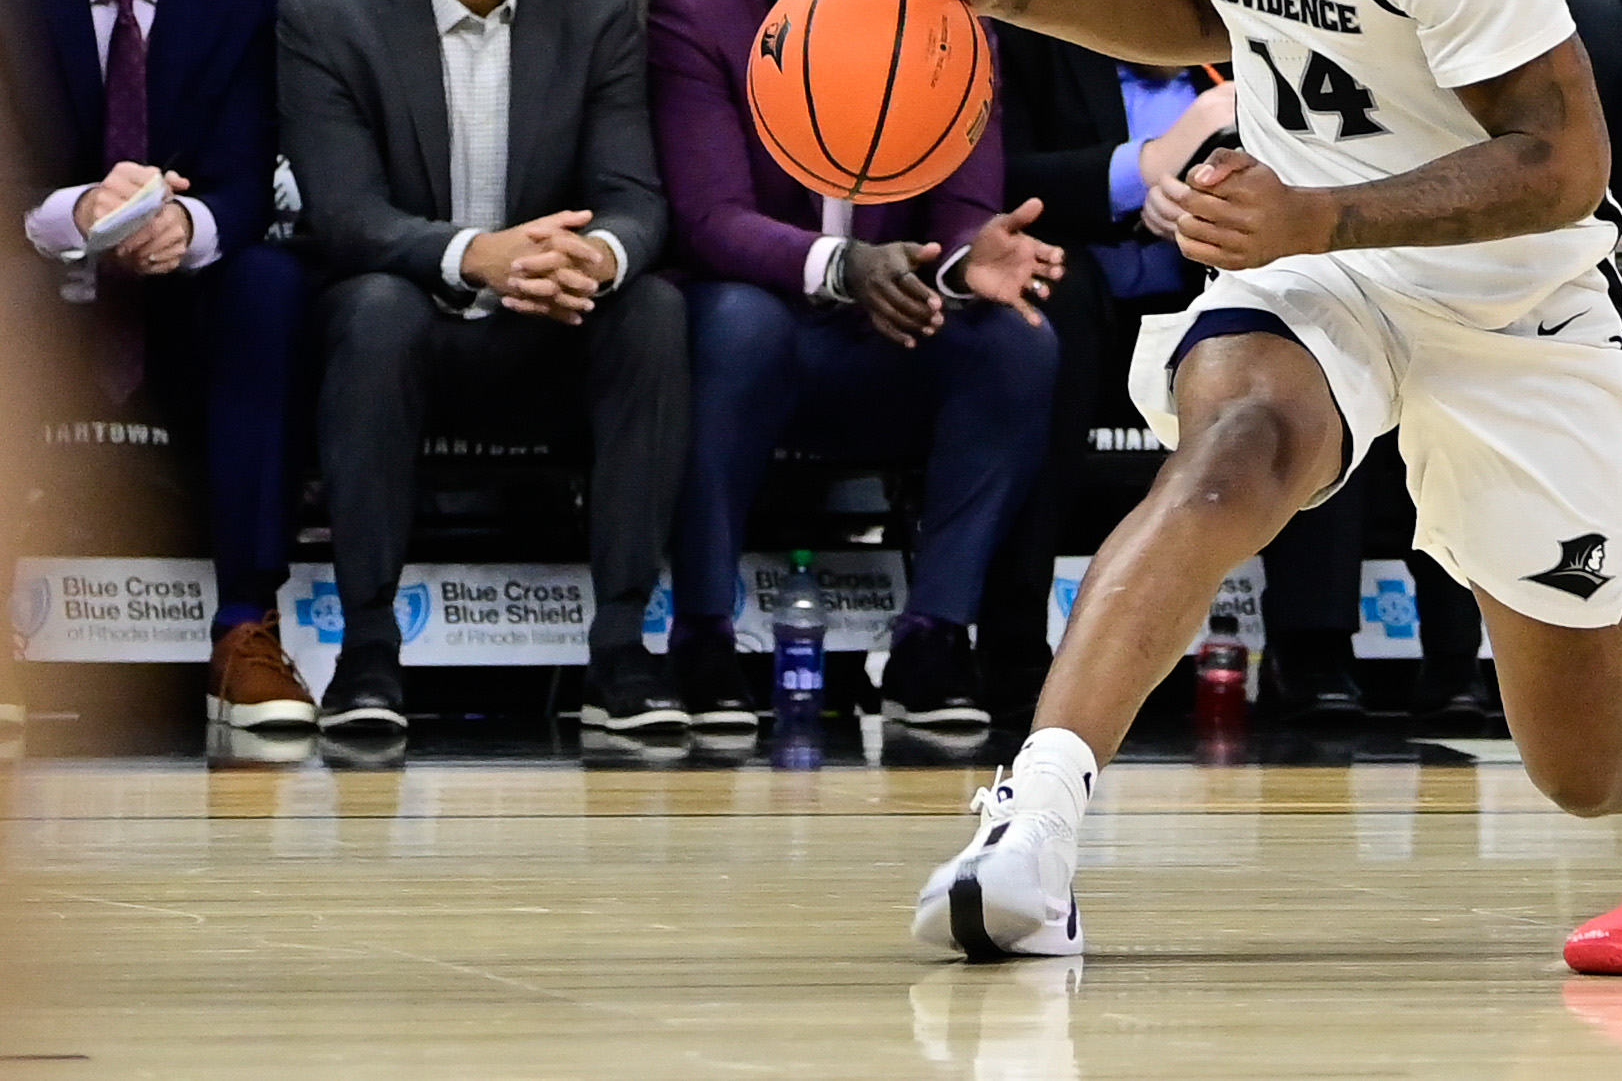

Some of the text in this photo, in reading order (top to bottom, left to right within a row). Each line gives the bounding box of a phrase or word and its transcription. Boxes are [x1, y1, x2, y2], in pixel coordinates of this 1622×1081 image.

[1246, 38, 1393, 142] 14
[63, 576, 201, 598] Blue Cross
[442, 581, 581, 602] Blue Cross
[65, 600, 204, 620] Blue Shield
[444, 604, 583, 624] Blue Shield
